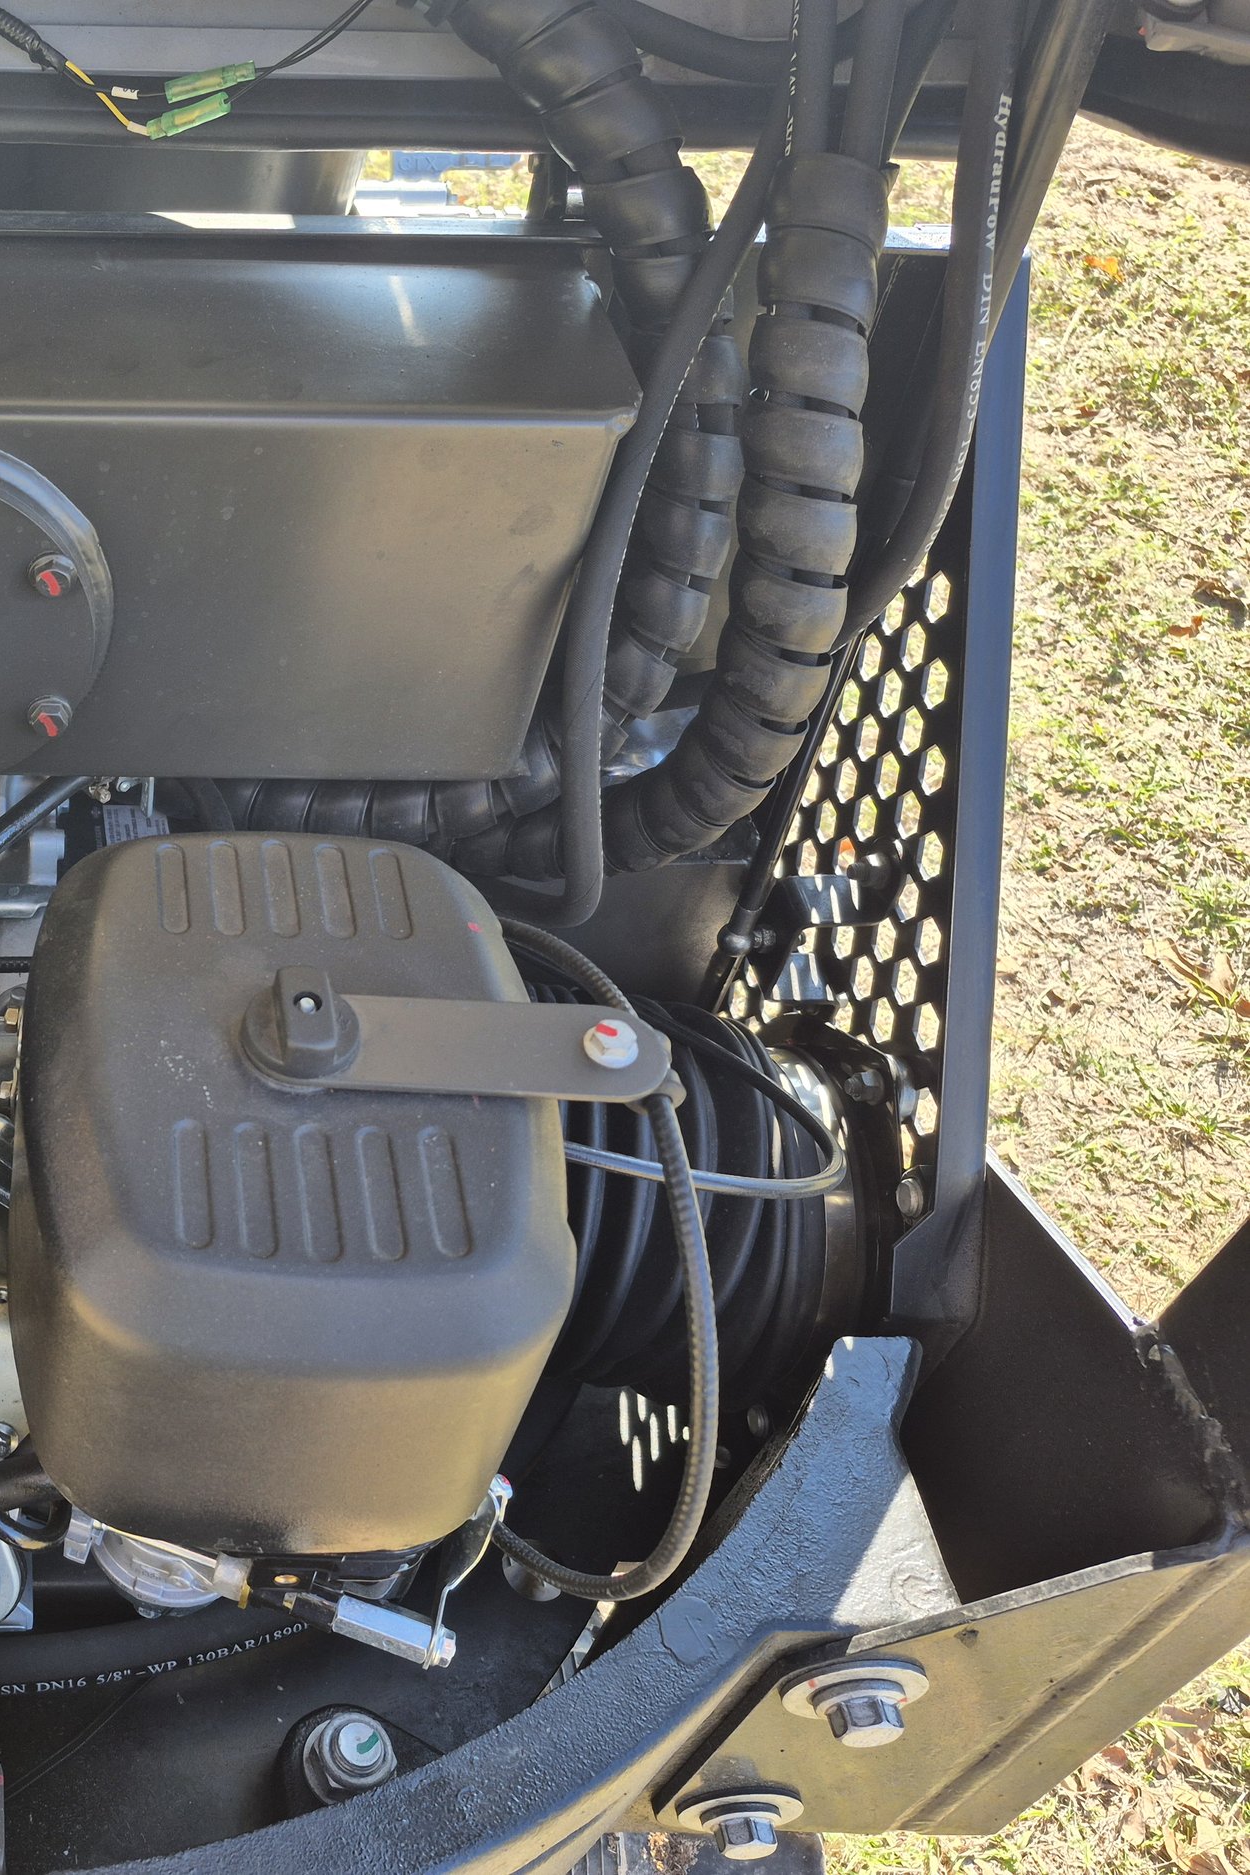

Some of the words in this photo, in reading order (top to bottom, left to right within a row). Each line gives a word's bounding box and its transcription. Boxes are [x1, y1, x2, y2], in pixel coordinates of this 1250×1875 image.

[985, 93, 1013, 251] HydrauPow
[979, 272, 993, 326] DIN
[36, 1677, 87, 1693] DN16
